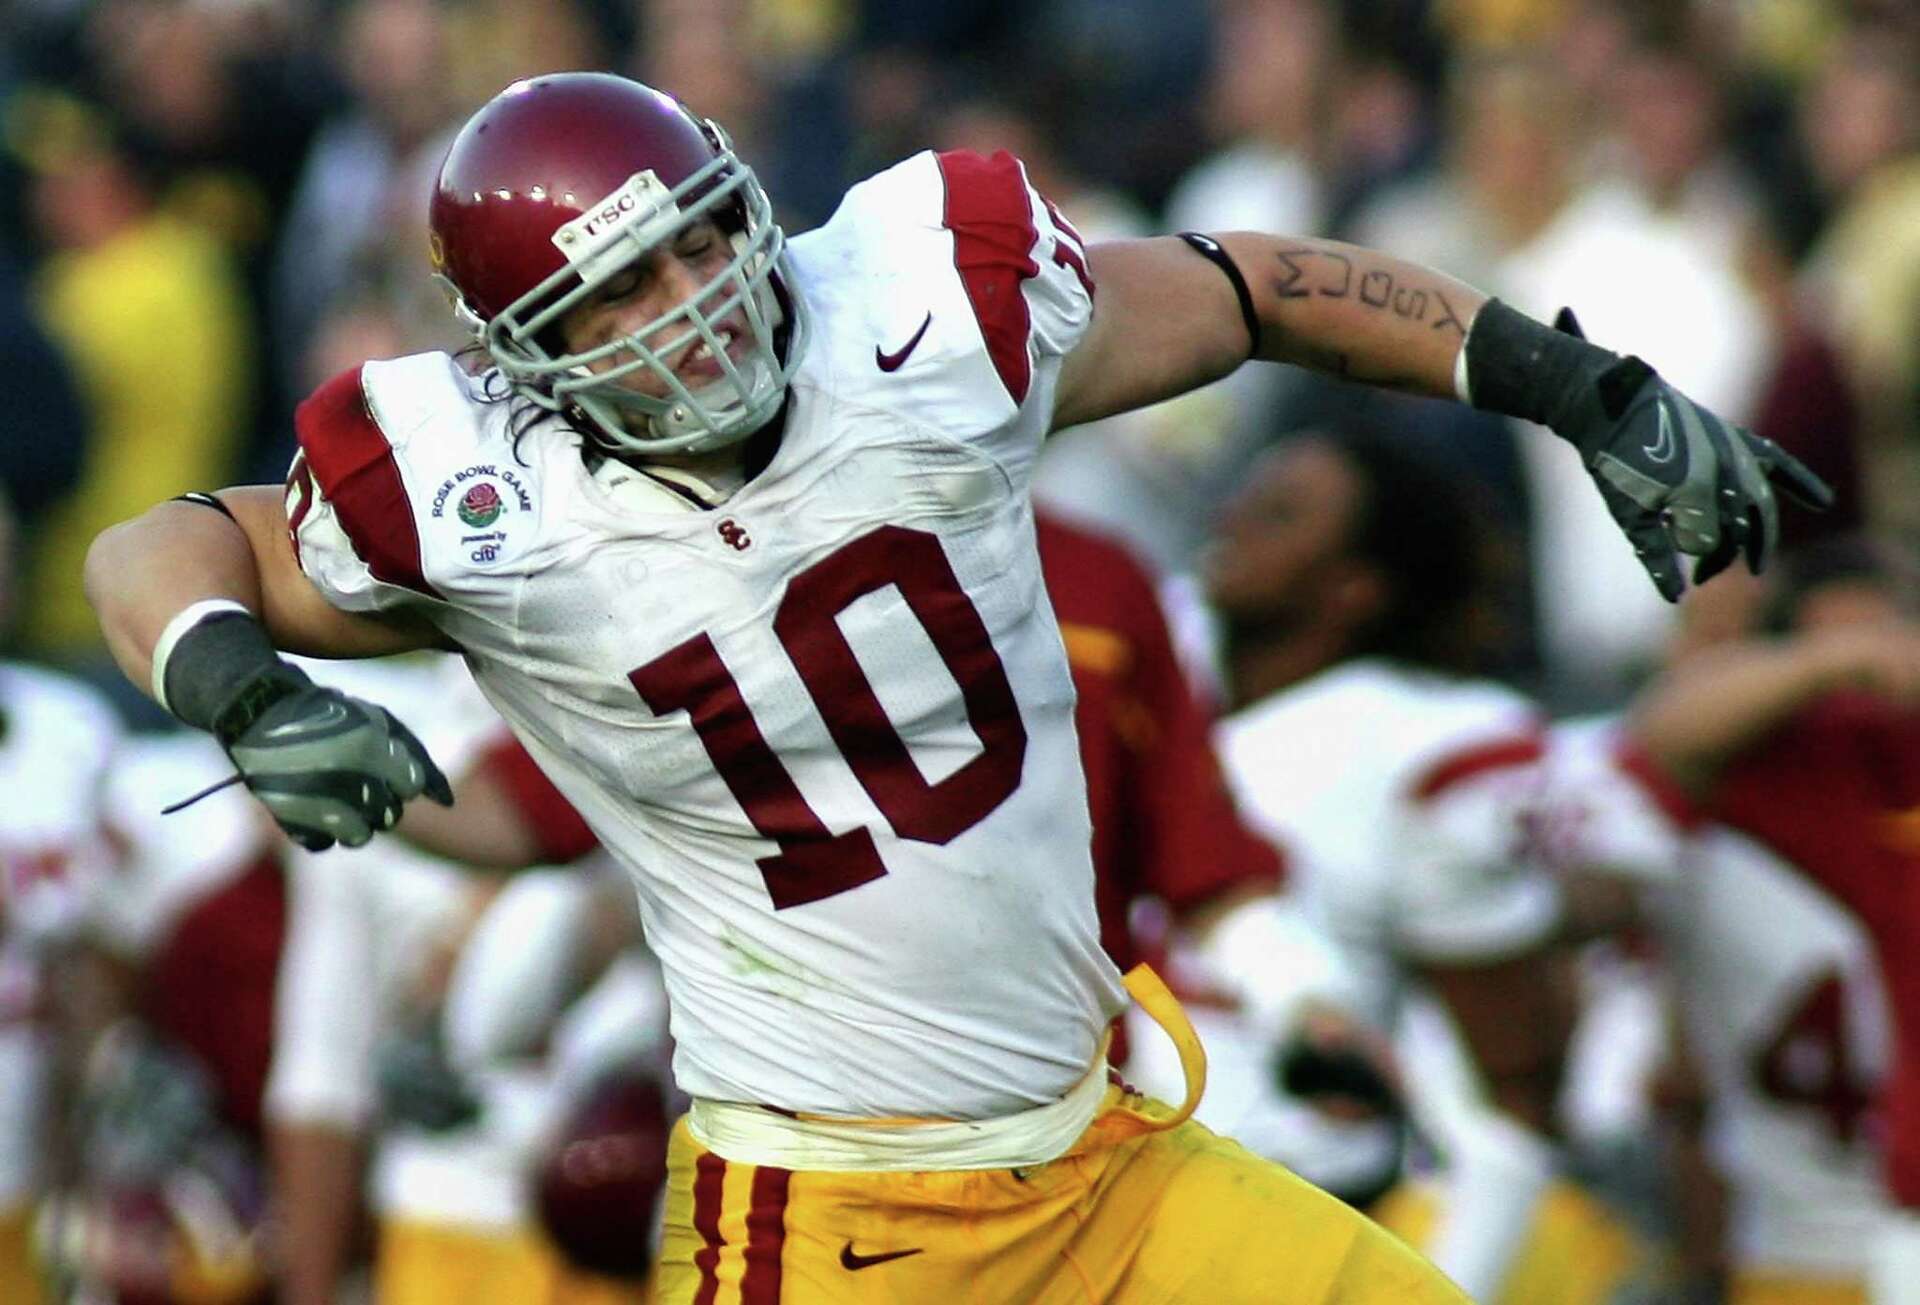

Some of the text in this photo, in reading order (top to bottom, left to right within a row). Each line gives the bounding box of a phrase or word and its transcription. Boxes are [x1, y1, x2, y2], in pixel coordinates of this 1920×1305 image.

[583, 194, 635, 236] USC
[432, 465, 532, 518] ROSE BOWL GAME
[627, 524, 1028, 911] 10
